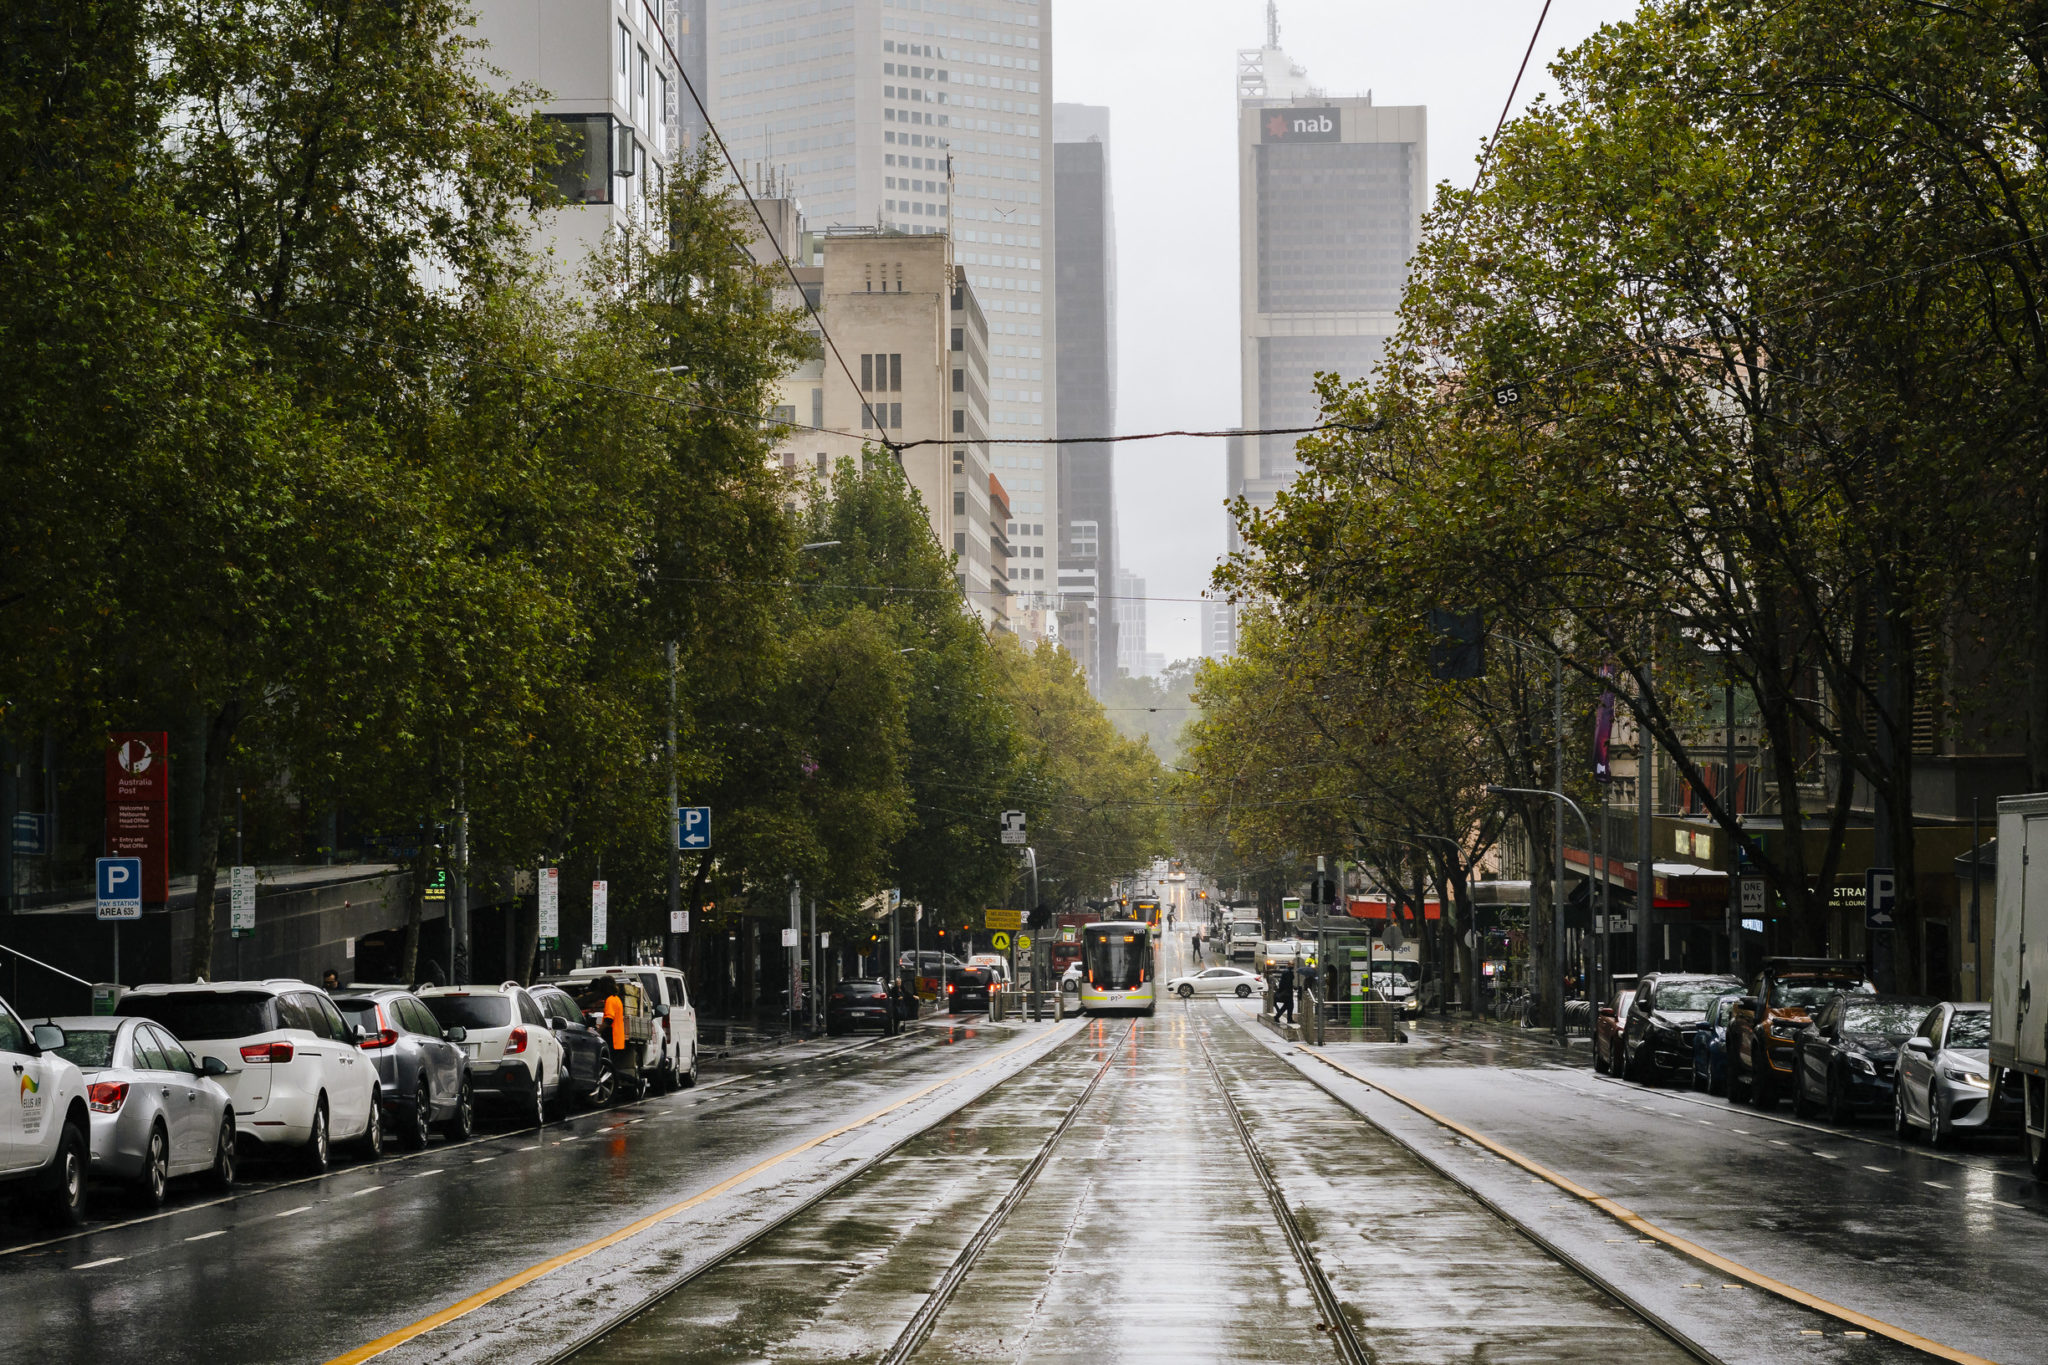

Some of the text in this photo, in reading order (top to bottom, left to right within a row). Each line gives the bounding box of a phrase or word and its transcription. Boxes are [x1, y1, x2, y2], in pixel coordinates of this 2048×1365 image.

[1293, 115, 1333, 132] nab
[1497, 388, 1518, 404] 55
[118, 778, 153, 786] Australia
[118, 786, 136, 794] Post
[685, 810, 702, 831] P
[108, 866, 130, 894] P
[1743, 882, 1762, 891] ONE
[1873, 874, 1895, 909] P
[232, 889, 243, 900] 2P
[1743, 893, 1763, 901] WAY
[100, 907, 135, 916] AREA 635
